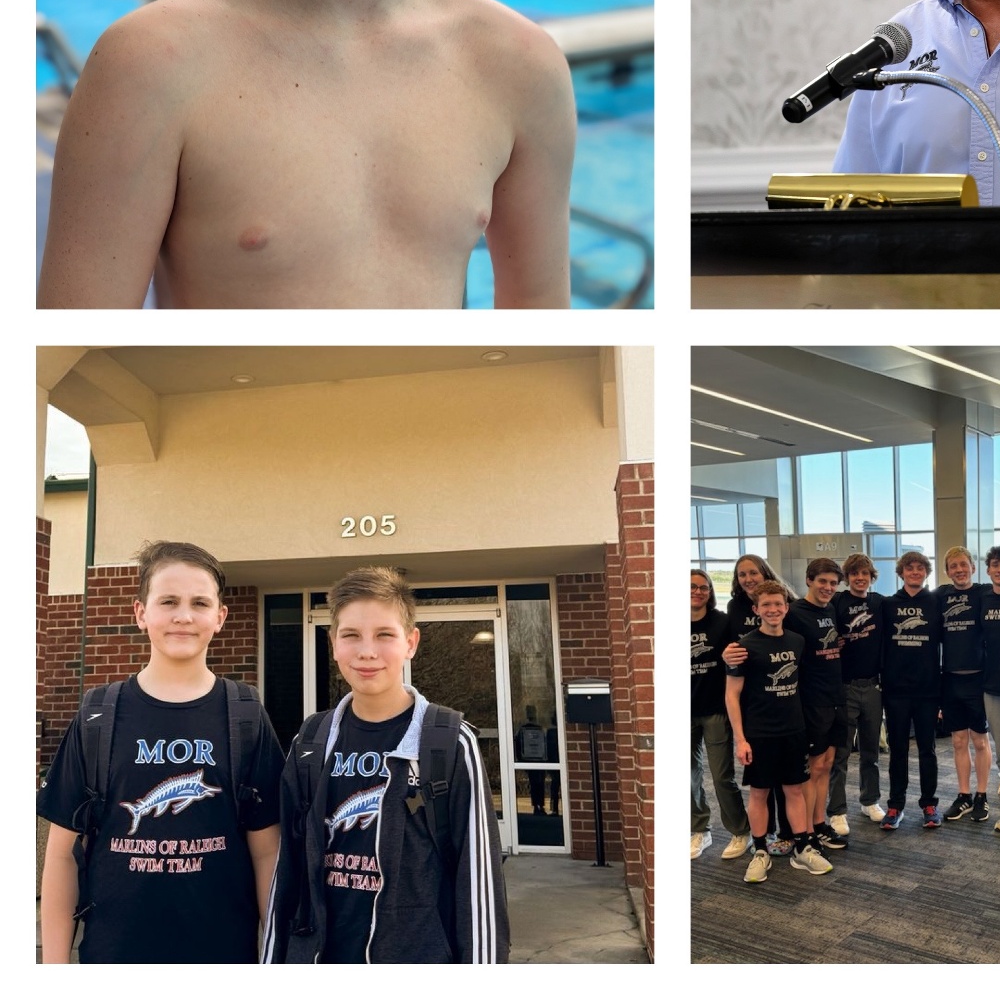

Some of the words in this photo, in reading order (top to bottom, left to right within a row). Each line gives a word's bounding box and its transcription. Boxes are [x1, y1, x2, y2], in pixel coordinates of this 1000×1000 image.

[341, 514, 396, 538] 205
[897, 607, 924, 617] MOR
[690, 633, 708, 643] OR
[769, 651, 796, 662] MOR
[135, 739, 216, 766] MOR
[110, 838, 157, 855] MARLINS
[158, 840, 178, 855] OF
[179, 836, 227, 854] RALEIGH
[129, 857, 165, 872] SWIM
[166, 857, 204, 873] TEAM
[345, 854, 361, 870] OF
[350, 873, 382, 892] TEAM
